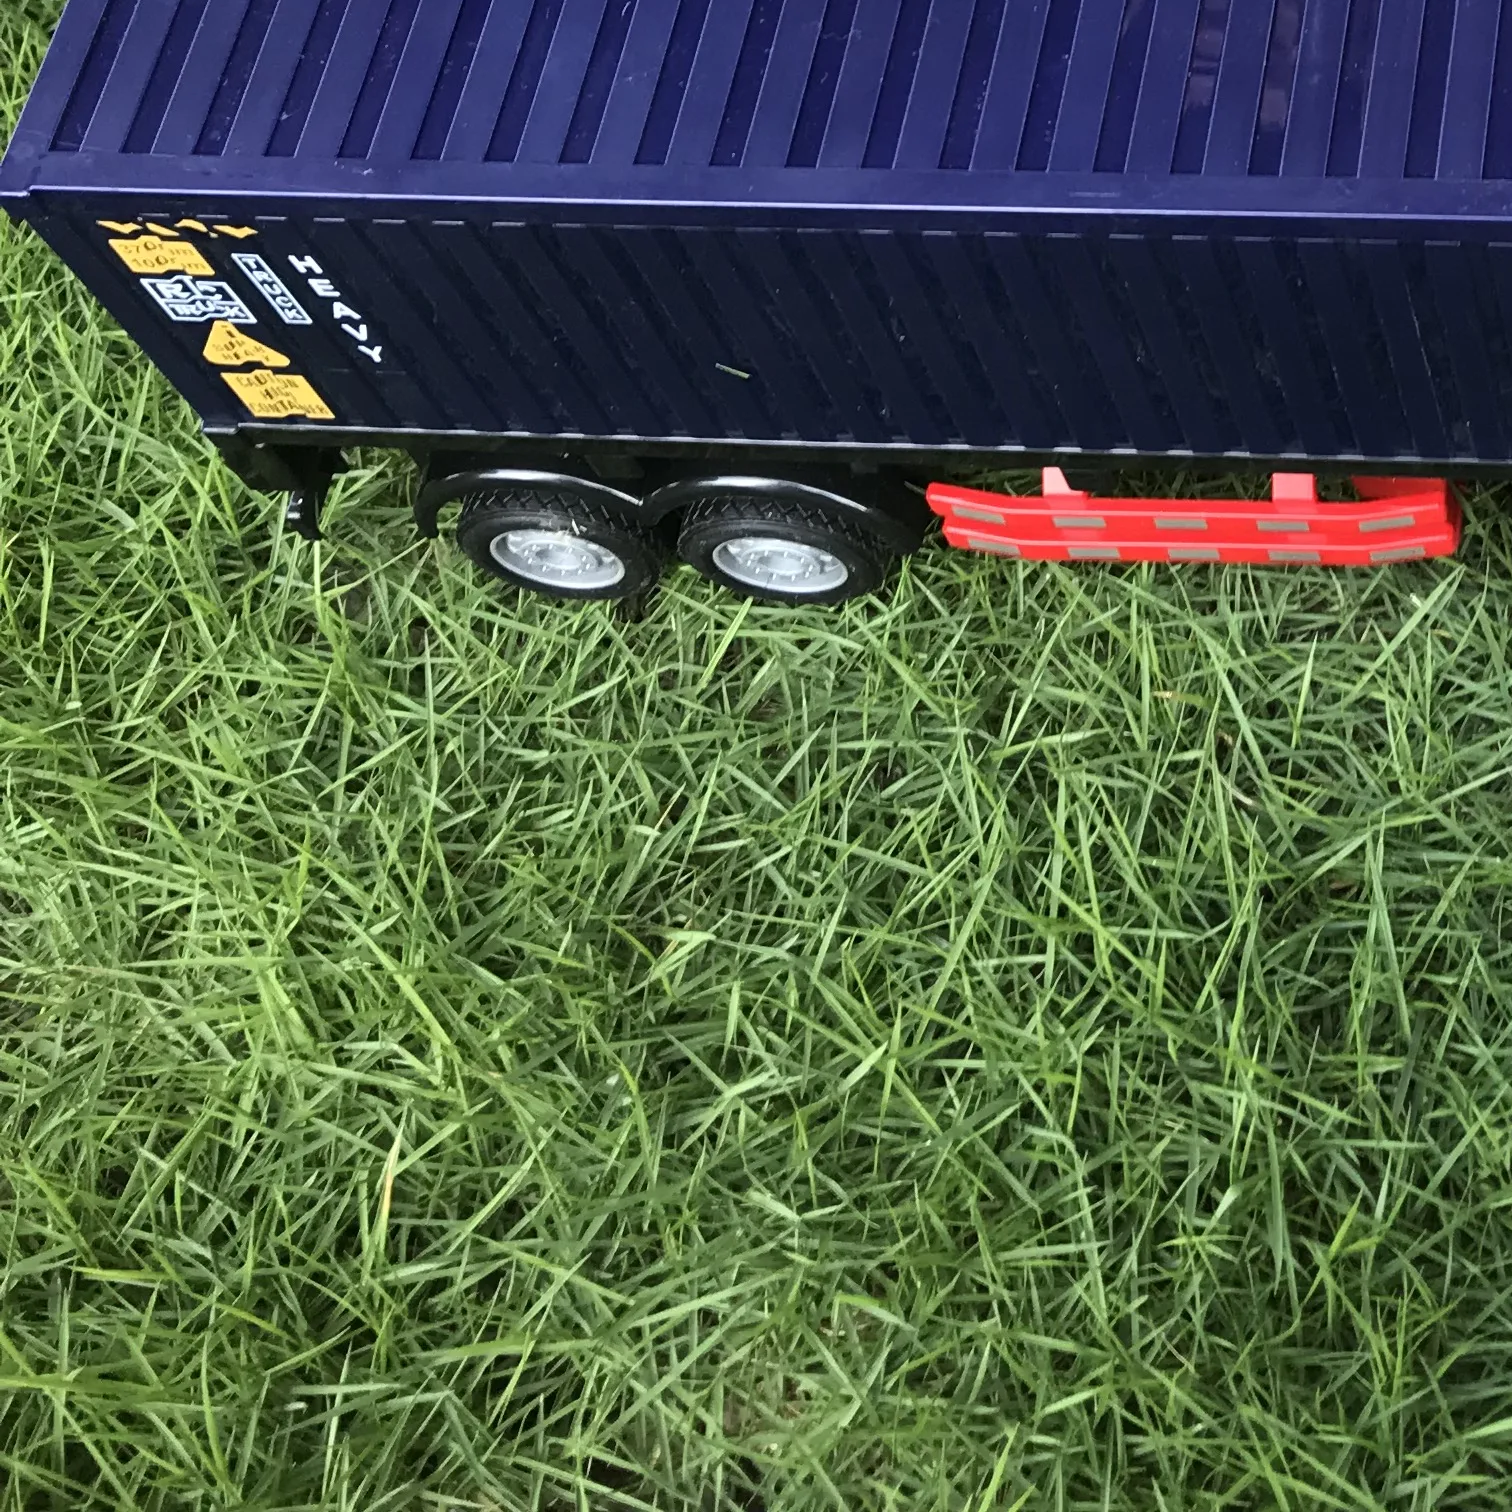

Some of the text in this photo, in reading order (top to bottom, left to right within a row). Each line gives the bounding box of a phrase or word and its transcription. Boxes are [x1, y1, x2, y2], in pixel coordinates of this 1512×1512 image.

[242, 257, 304, 320] TRUCK
[287, 254, 383, 363] HEAVY
[236, 372, 299, 388] CAUTON
